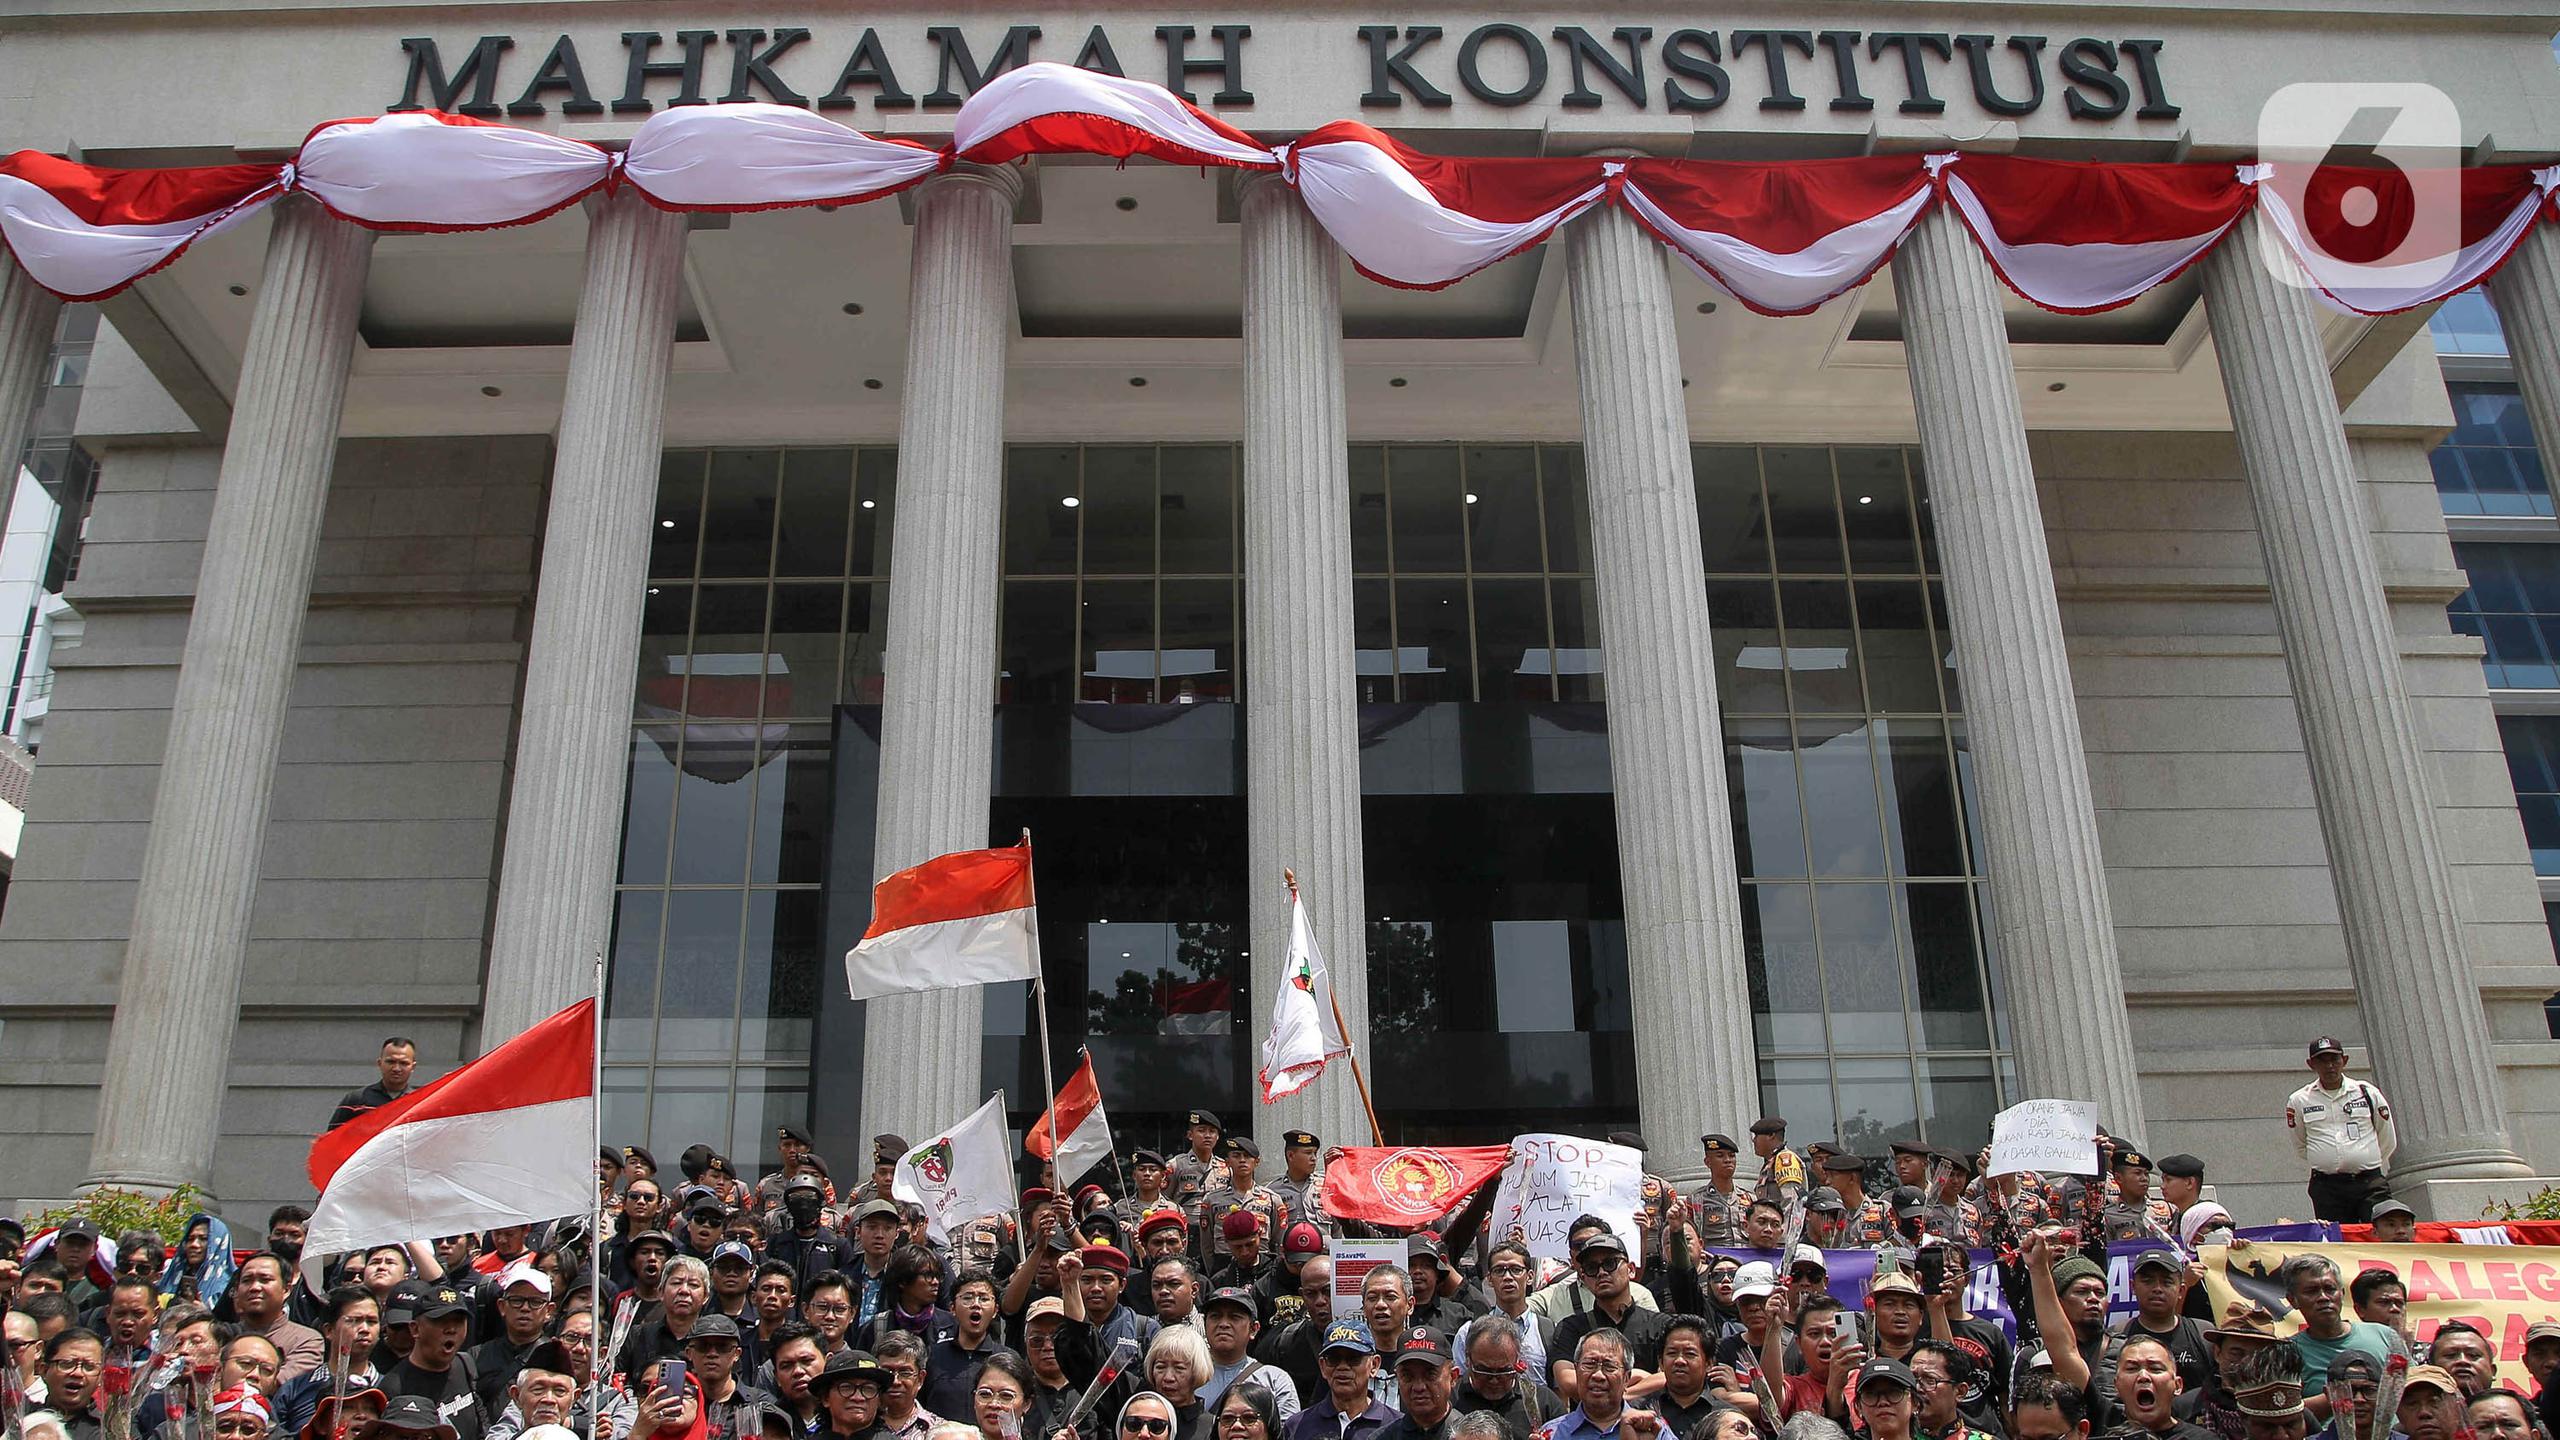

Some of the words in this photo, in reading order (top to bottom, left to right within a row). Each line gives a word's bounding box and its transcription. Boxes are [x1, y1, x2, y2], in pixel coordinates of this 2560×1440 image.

[386, 24, 1254, 116] MAHKAMAH
[1358, 23, 2182, 120] KONSTITUSI
[1524, 1140, 1604, 1169] STOP
[1568, 1170, 1613, 1197] JADI
[1398, 1192, 1431, 1208] PMKRI
[1523, 1191, 1591, 1215] ALAT
[1328, 1325, 1361, 1342] GWK
